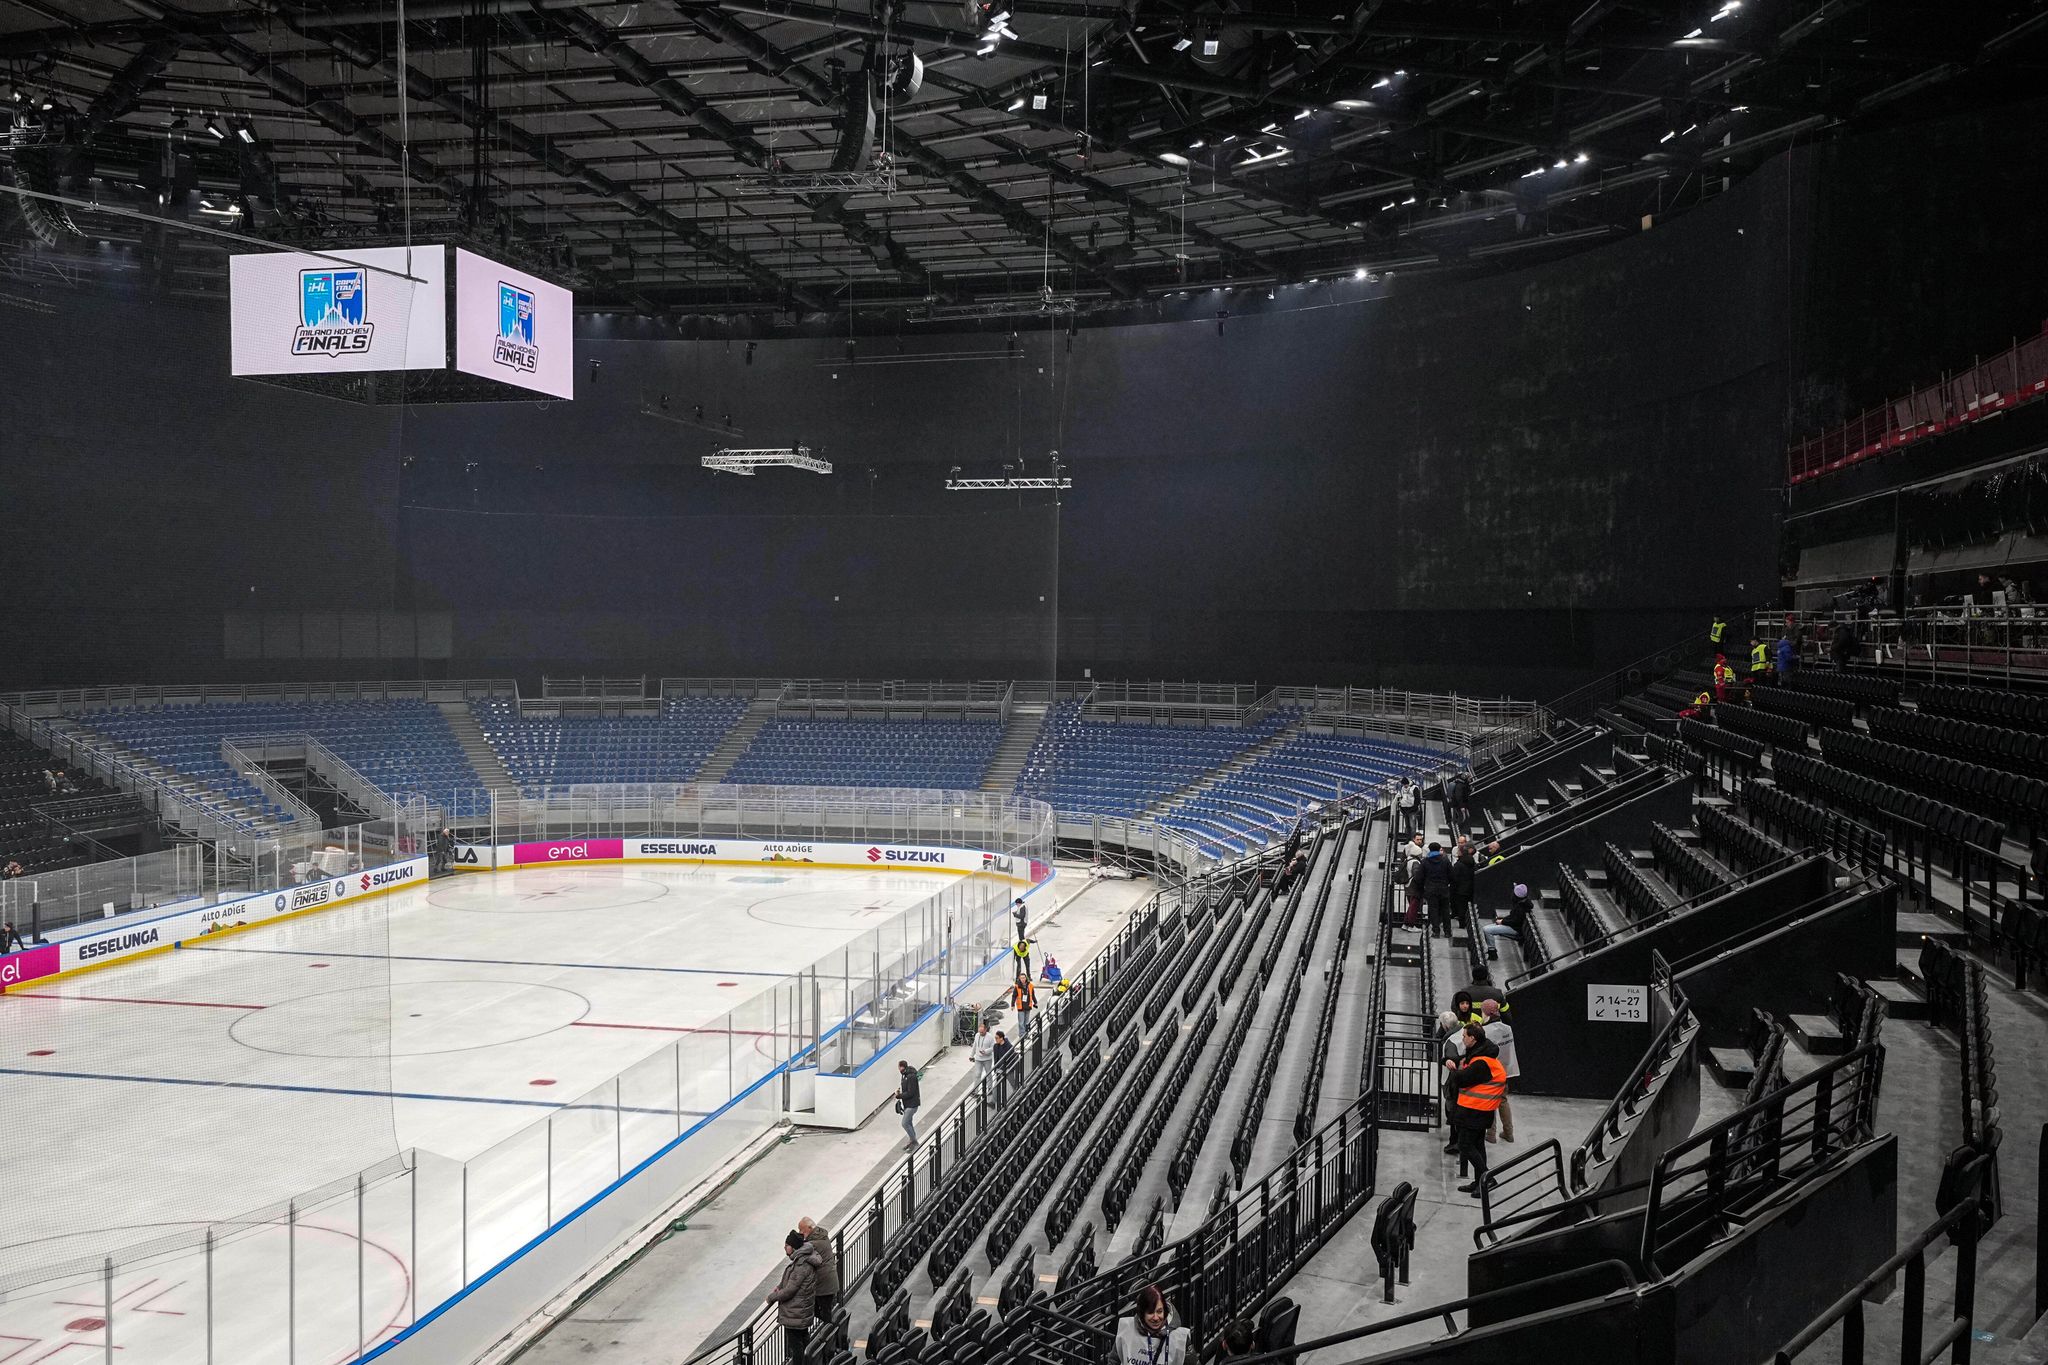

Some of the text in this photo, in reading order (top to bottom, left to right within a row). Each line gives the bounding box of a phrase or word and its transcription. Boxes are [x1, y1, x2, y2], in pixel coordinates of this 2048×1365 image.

[296, 335, 368, 352] FINALS
[498, 339, 517, 350] MILANO
[496, 346, 535, 368] FINALS
[454, 847, 478, 864] LA
[548, 842, 588, 859] enel
[640, 844, 716, 854] ESSELUNGA
[885, 850, 944, 862] SUZUKI
[373, 866, 413, 886] SUZUKI
[294, 890, 328, 907] FINALS
[78, 928, 159, 960] ESSELUNGA
[0, 958, 20, 982] el
[1608, 996, 1640, 1006] 14-27
[1614, 1009, 1640, 1018] 1-13
